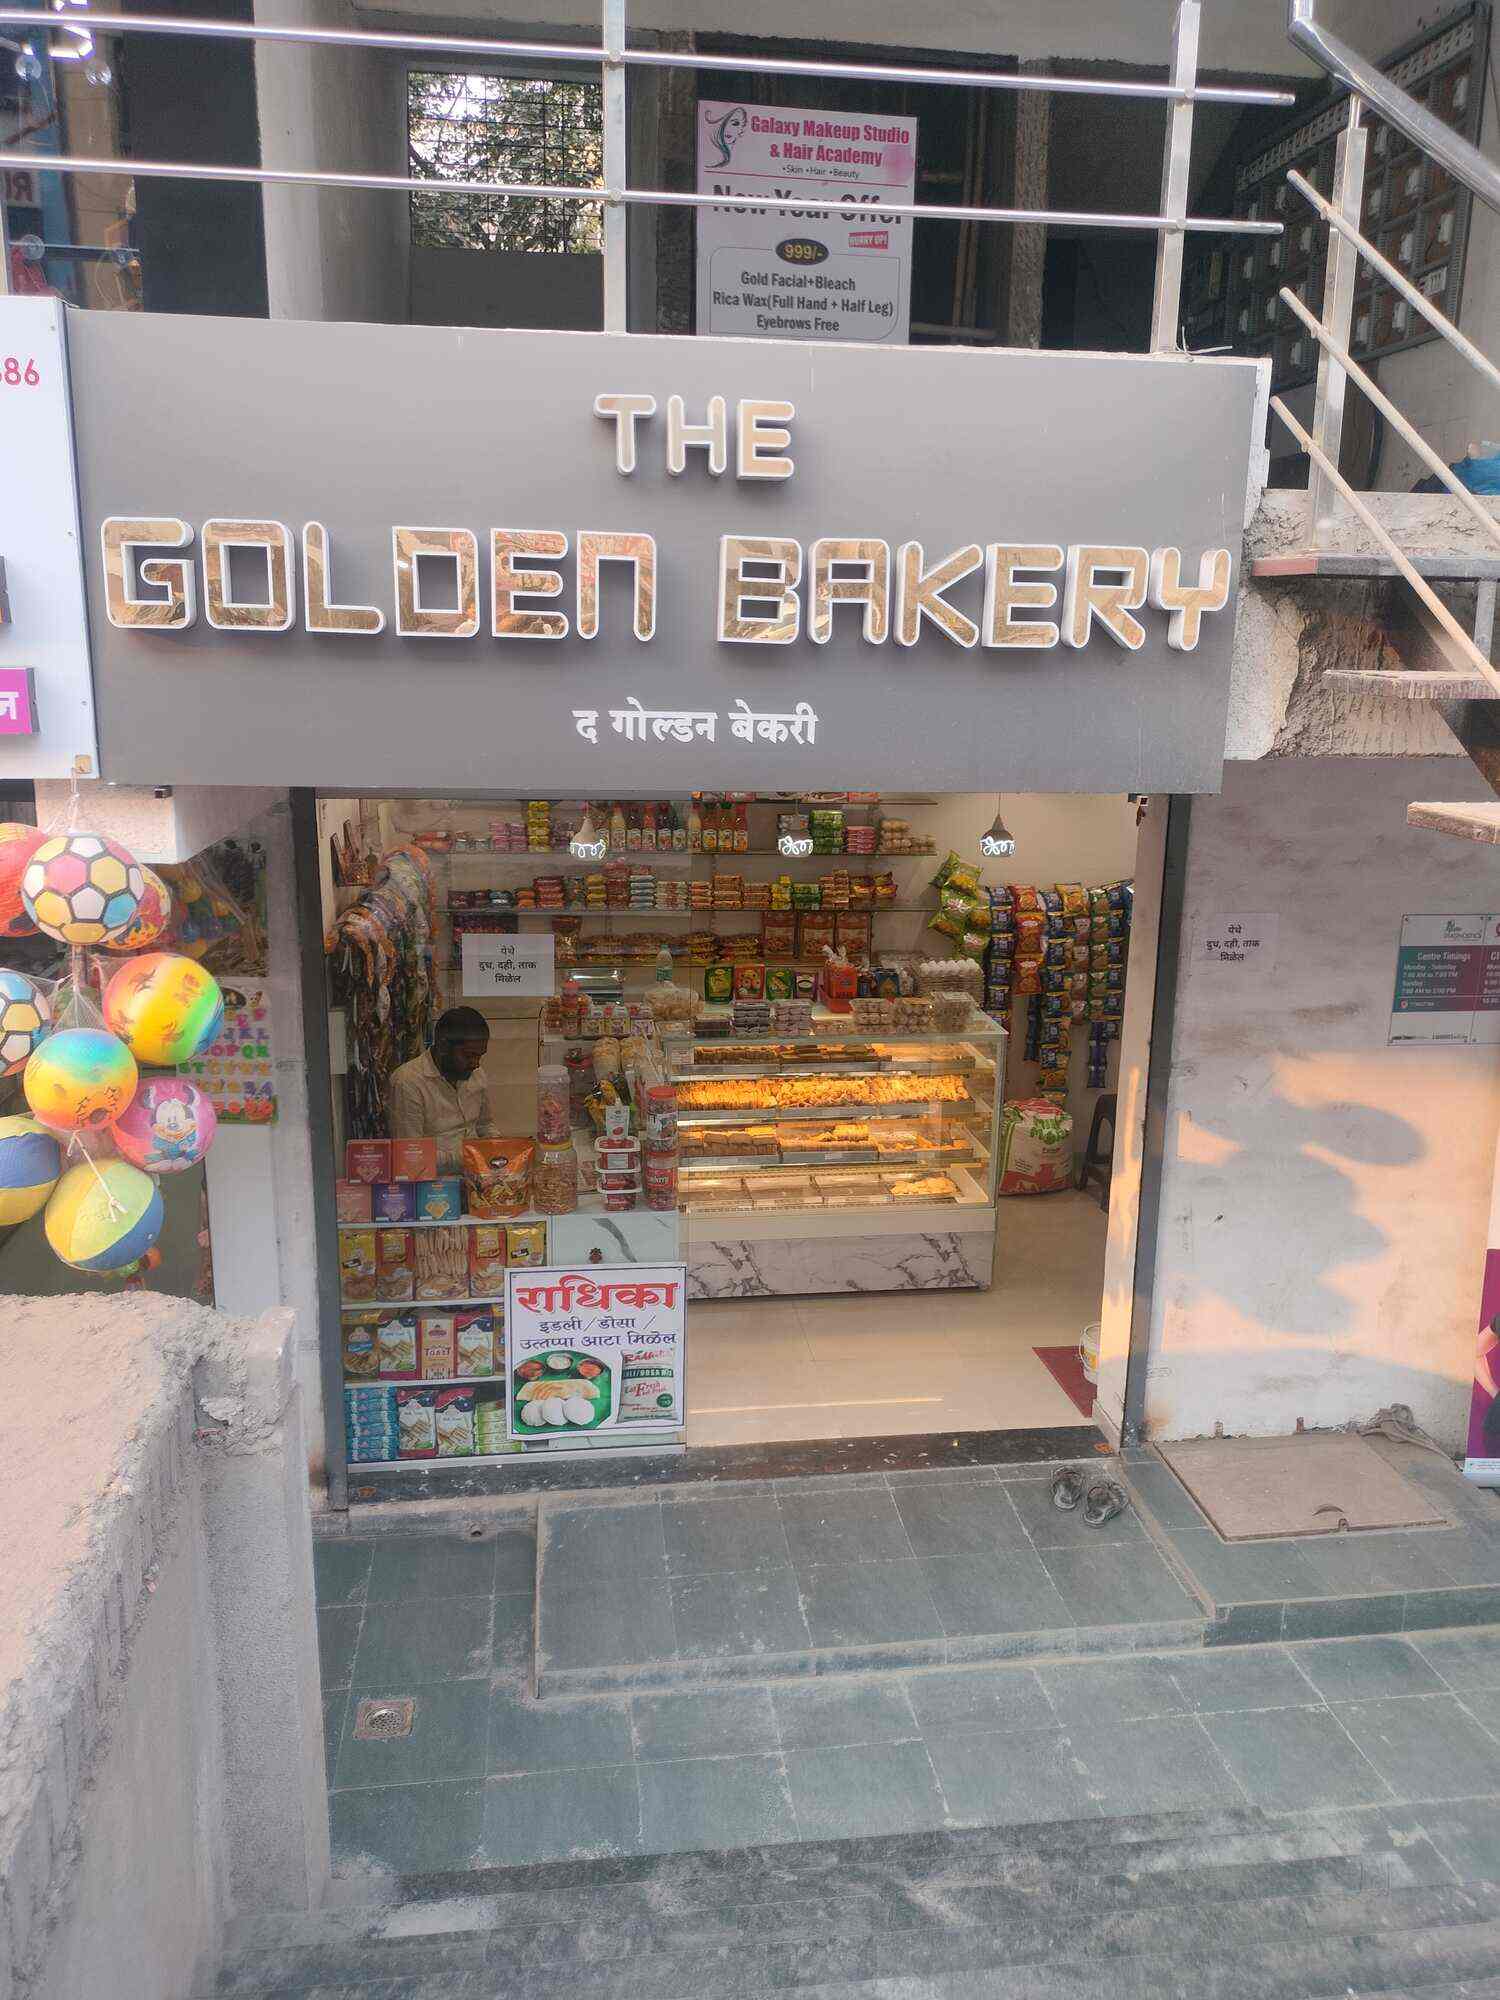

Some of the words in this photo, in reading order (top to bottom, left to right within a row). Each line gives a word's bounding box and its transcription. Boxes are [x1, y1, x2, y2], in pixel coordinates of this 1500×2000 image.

[751, 116, 800, 136] Galaxy
[803, 120, 860, 141] Makeup
[864, 125, 909, 144] Studio
[770, 144, 780, 157] &
[784, 143, 813, 159] Hair
[816, 145, 882, 167] Academy
[784, 244, 823, 260] 999/-
[741, 271, 768, 286] Gold
[772, 273, 856, 291] Facial+Bleach
[713, 291, 739, 306] Rica
[797, 296, 828, 312] Hand
[841, 298, 865, 313] Half
[869, 299, 893, 316] Leg)
[756, 315, 811, 331] Eyebrows
[814, 317, 840, 331] Free
[593, 394, 795, 480] THE
[100, 517, 657, 641] GOLDEN
[717, 535, 1232, 651] BAKERY
[571, 710, 600, 744] द
[608, 696, 718, 743] गोल्डन
[728, 698, 819, 744] बेकरी
[516, 1274, 678, 1313] राधिका
[520, 1336, 575, 1350] उत्तप्पा
[581, 1335, 621, 1347] आटा
[628, 1331, 677, 1345] मिळेल
